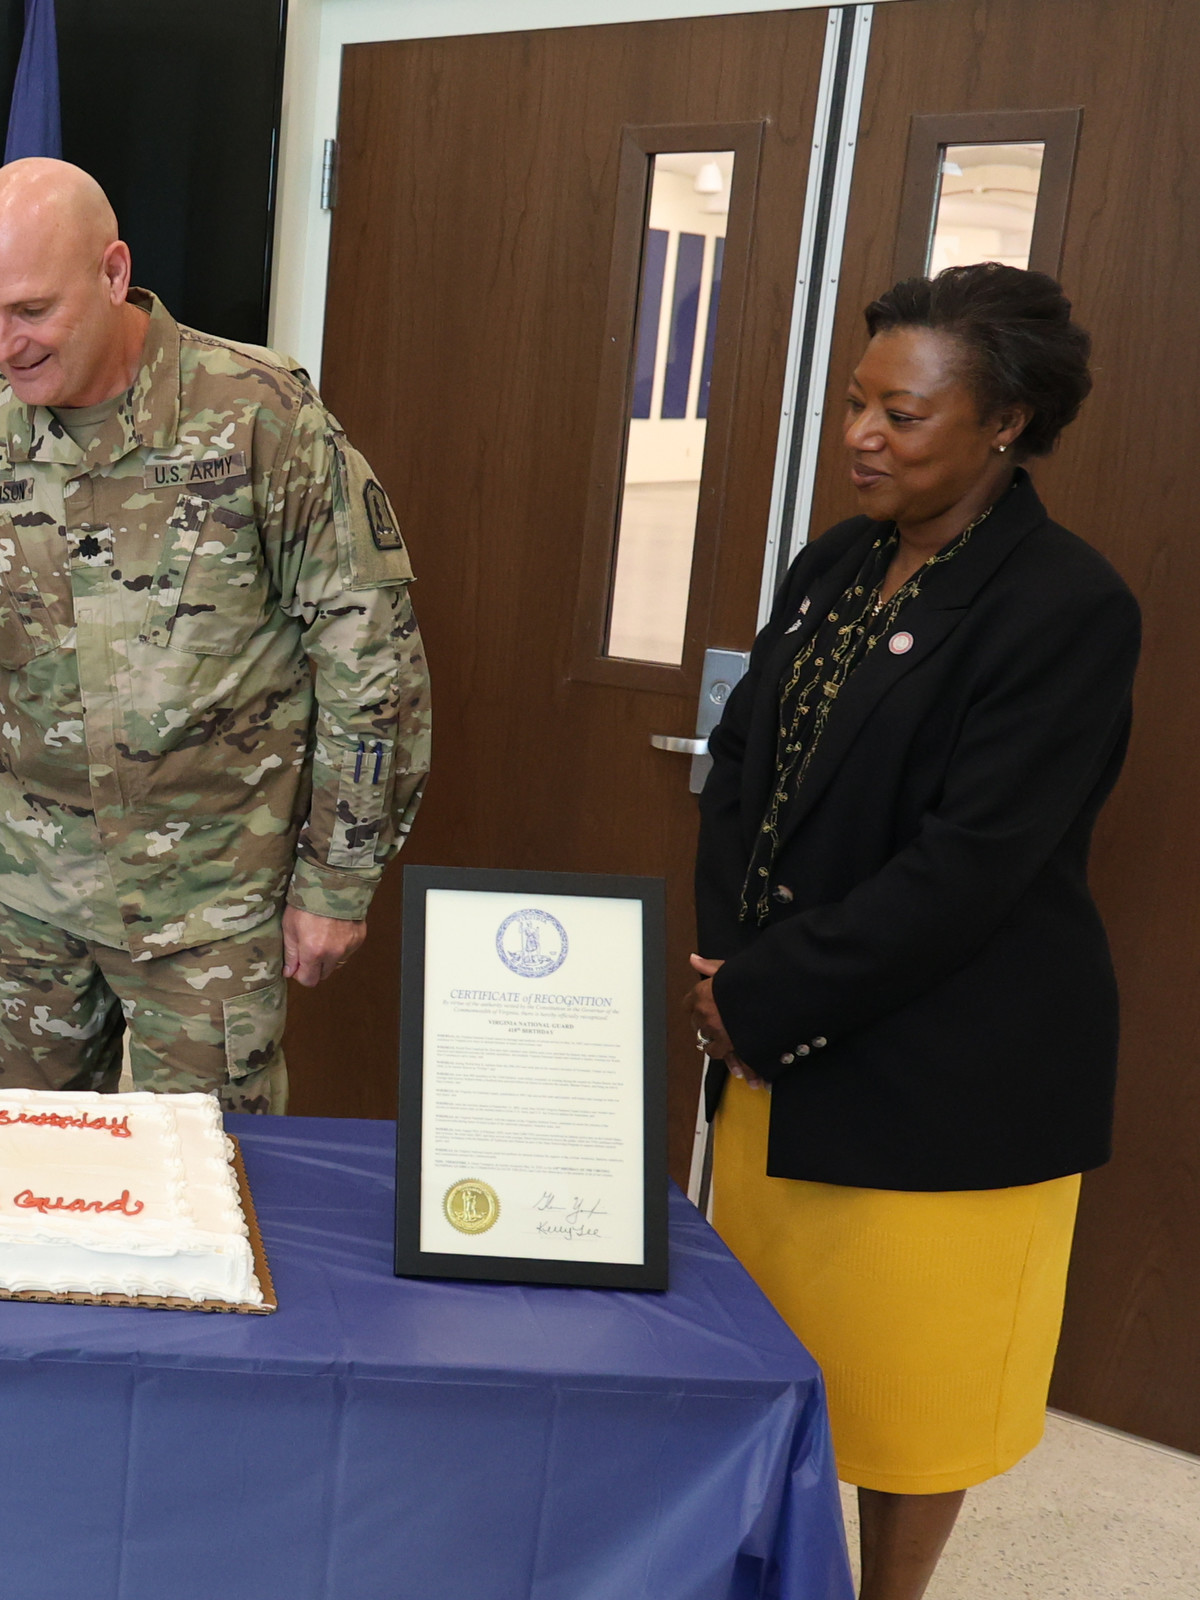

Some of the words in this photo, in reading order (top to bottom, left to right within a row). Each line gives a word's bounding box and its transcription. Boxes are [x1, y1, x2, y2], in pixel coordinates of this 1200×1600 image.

[154, 465, 183, 484] U.S.
[189, 458, 233, 482] ARMY
[449, 988, 520, 1002] CERTIFICATE
[522, 992, 534, 1005] of
[534, 993, 613, 1007] RECOGNITION
[518, 1020, 550, 1028] NATIONAL
[13, 1189, 145, 1216] Guard
